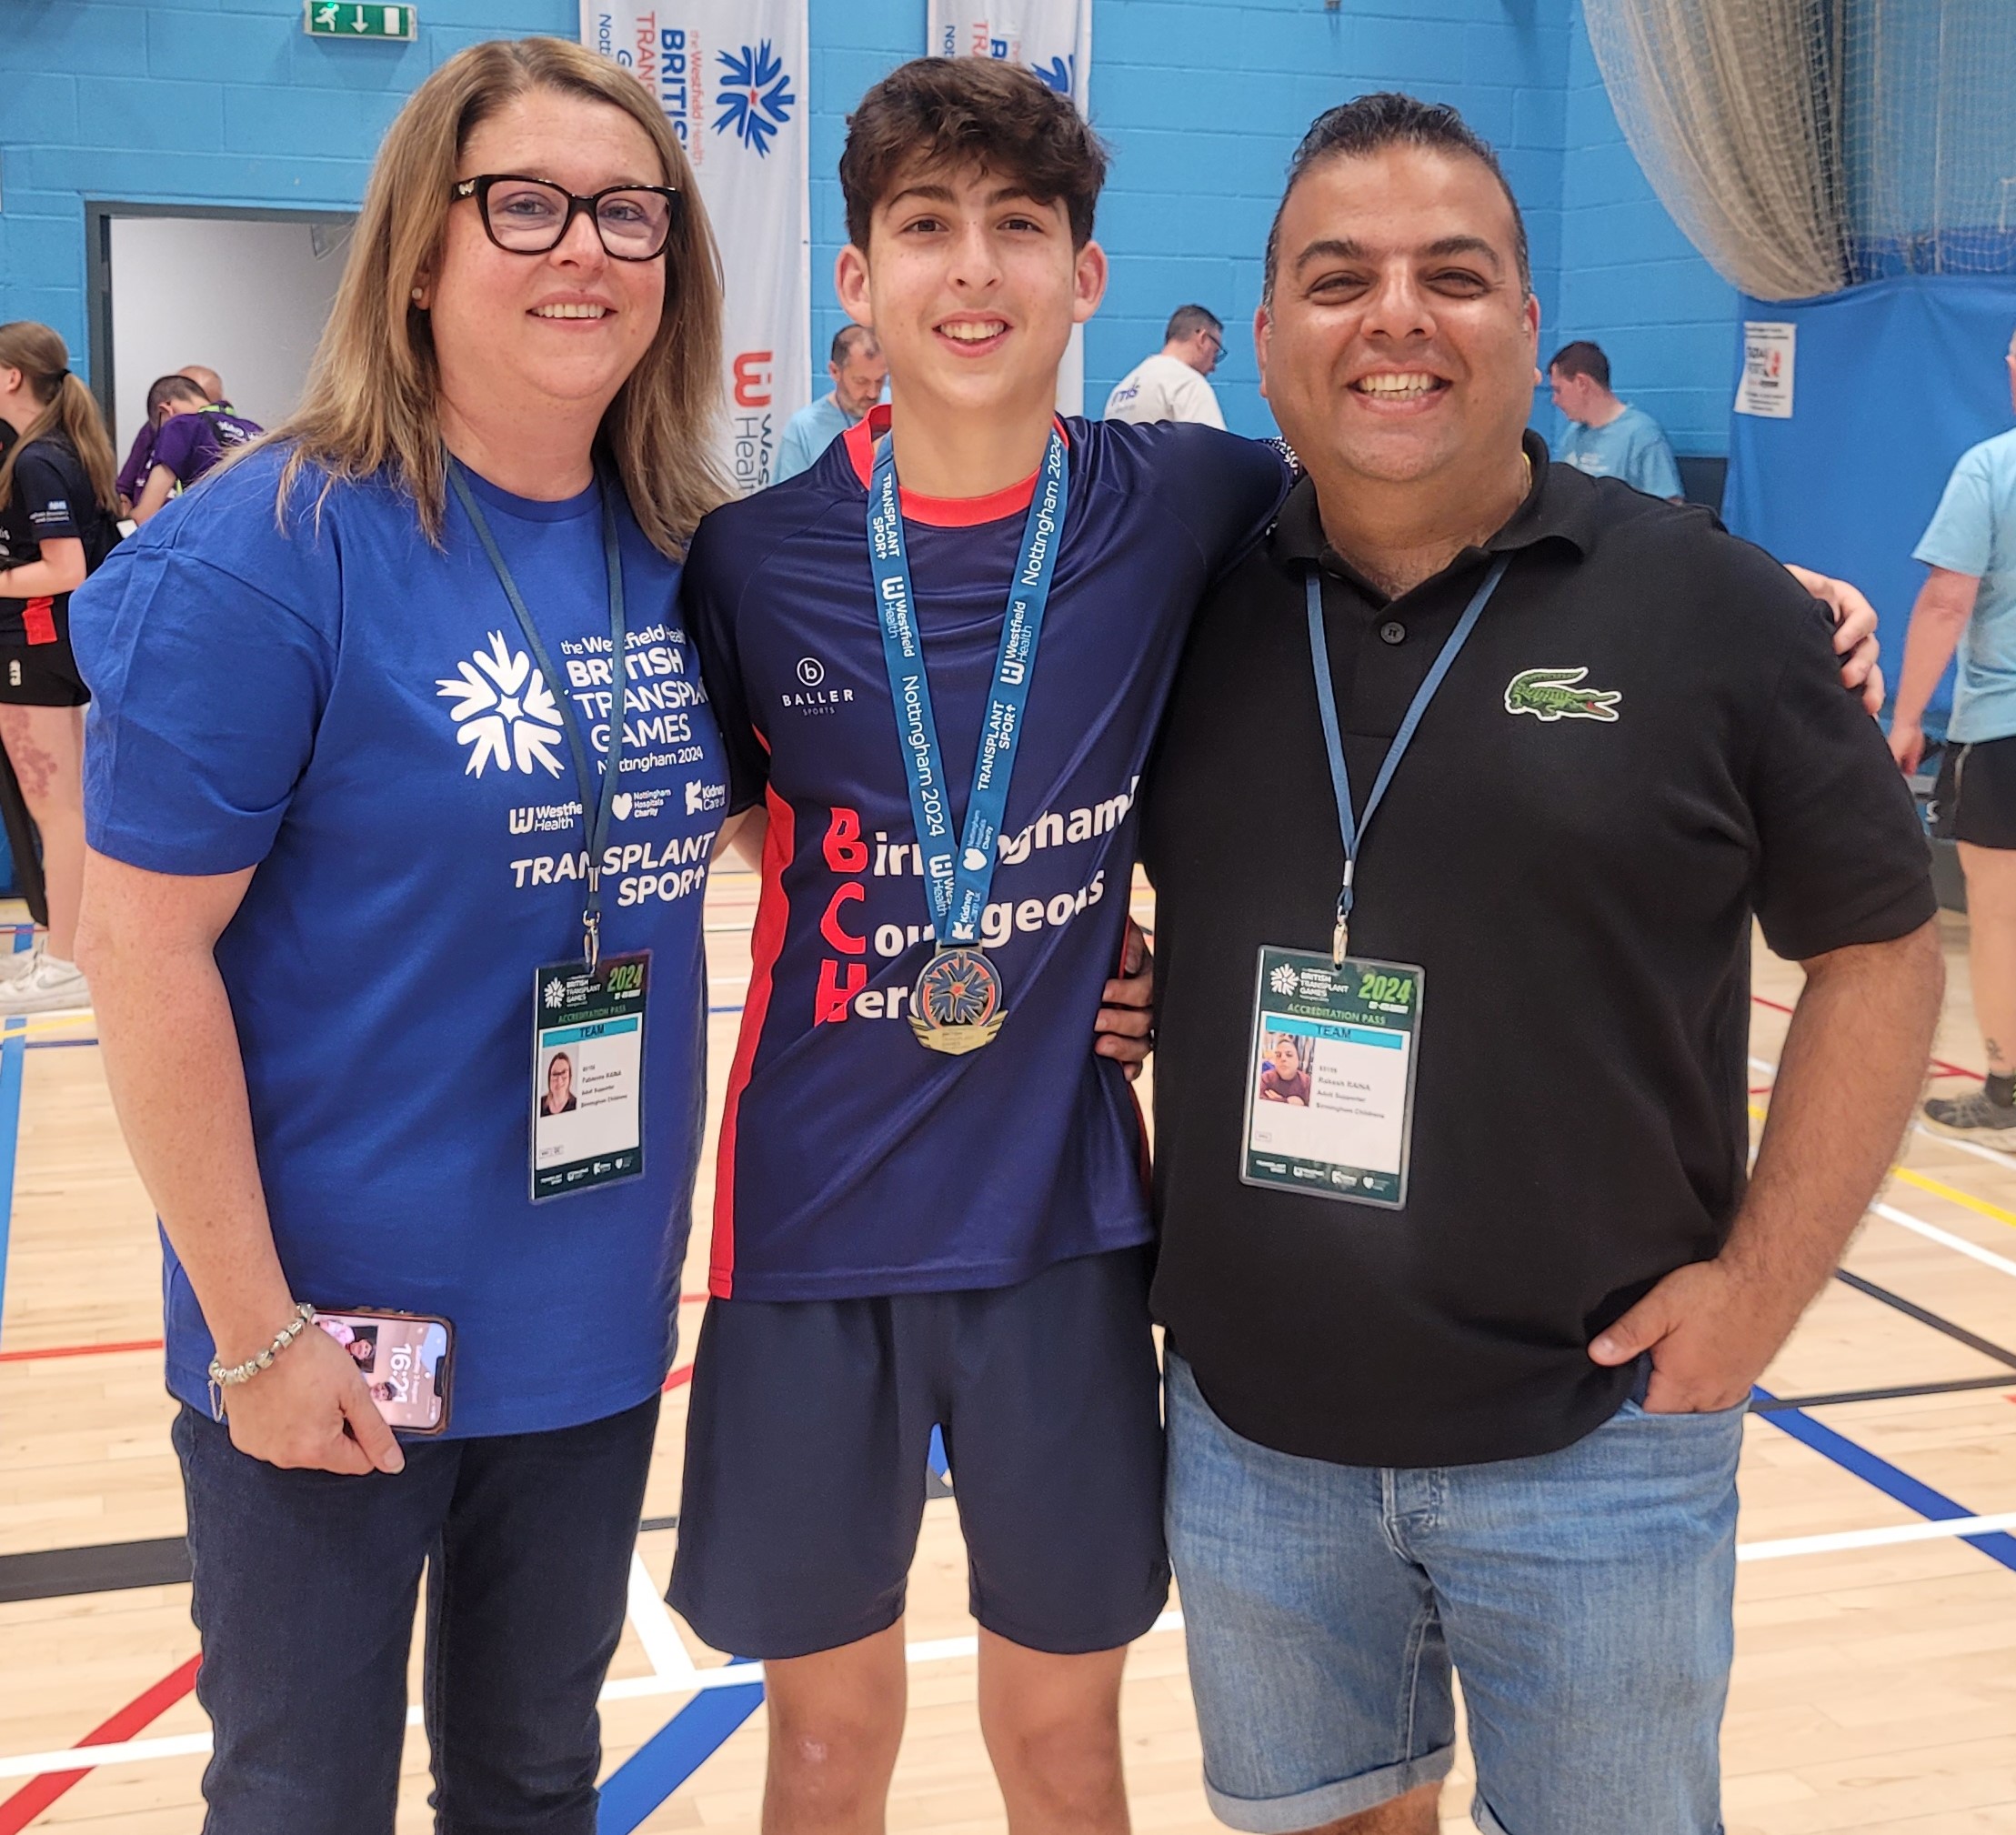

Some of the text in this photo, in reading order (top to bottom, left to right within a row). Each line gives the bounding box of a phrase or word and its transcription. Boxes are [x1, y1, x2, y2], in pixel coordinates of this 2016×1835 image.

[882, 472, 900, 557] TRANSPLANT
[1020, 434, 1062, 586] Nottingham 2024
[884, 601, 899, 639] Health
[895, 598, 916, 658] Westfield
[1005, 600, 1026, 659] Westfield
[561, 640, 584, 655] the
[581, 624, 665, 653] Wefield
[1017, 624, 1033, 663] Health
[567, 647, 684, 687] BRTISH
[782, 688, 854, 707] BALLER
[802, 707, 835, 716] SPORTS
[591, 713, 692, 753] GAMES
[977, 700, 1004, 791] TRANSPLANT
[597, 746, 704, 775] Nttingham 2024
[902, 675, 946, 837] Nottingham 2024
[633, 788, 672, 800] Nottingham
[634, 798, 664, 809] Hospitals
[702, 784, 726, 799] Kidney
[534, 817, 574, 832] Health
[634, 807, 658, 817] Charity
[982, 826, 993, 850] Charity
[932, 878, 947, 918] Health
[959, 889, 974, 923] Kidney
[607, 964, 644, 992] 2024
[1299, 988, 1328, 997] GAMES
[1300, 979, 1349, 993] TRANSPLANT
[1358, 973, 1413, 1003] 2024
[558, 1008, 609, 1024] ACCREDITATION
[1288, 1003, 1360, 1022] ACCREDITATION
[1361, 1013, 1386, 1026] PASS
[579, 1024, 605, 1038] TEAM
[1318, 1025, 1351, 1039] TEAM
[389, 1342, 412, 1402] 16:21
